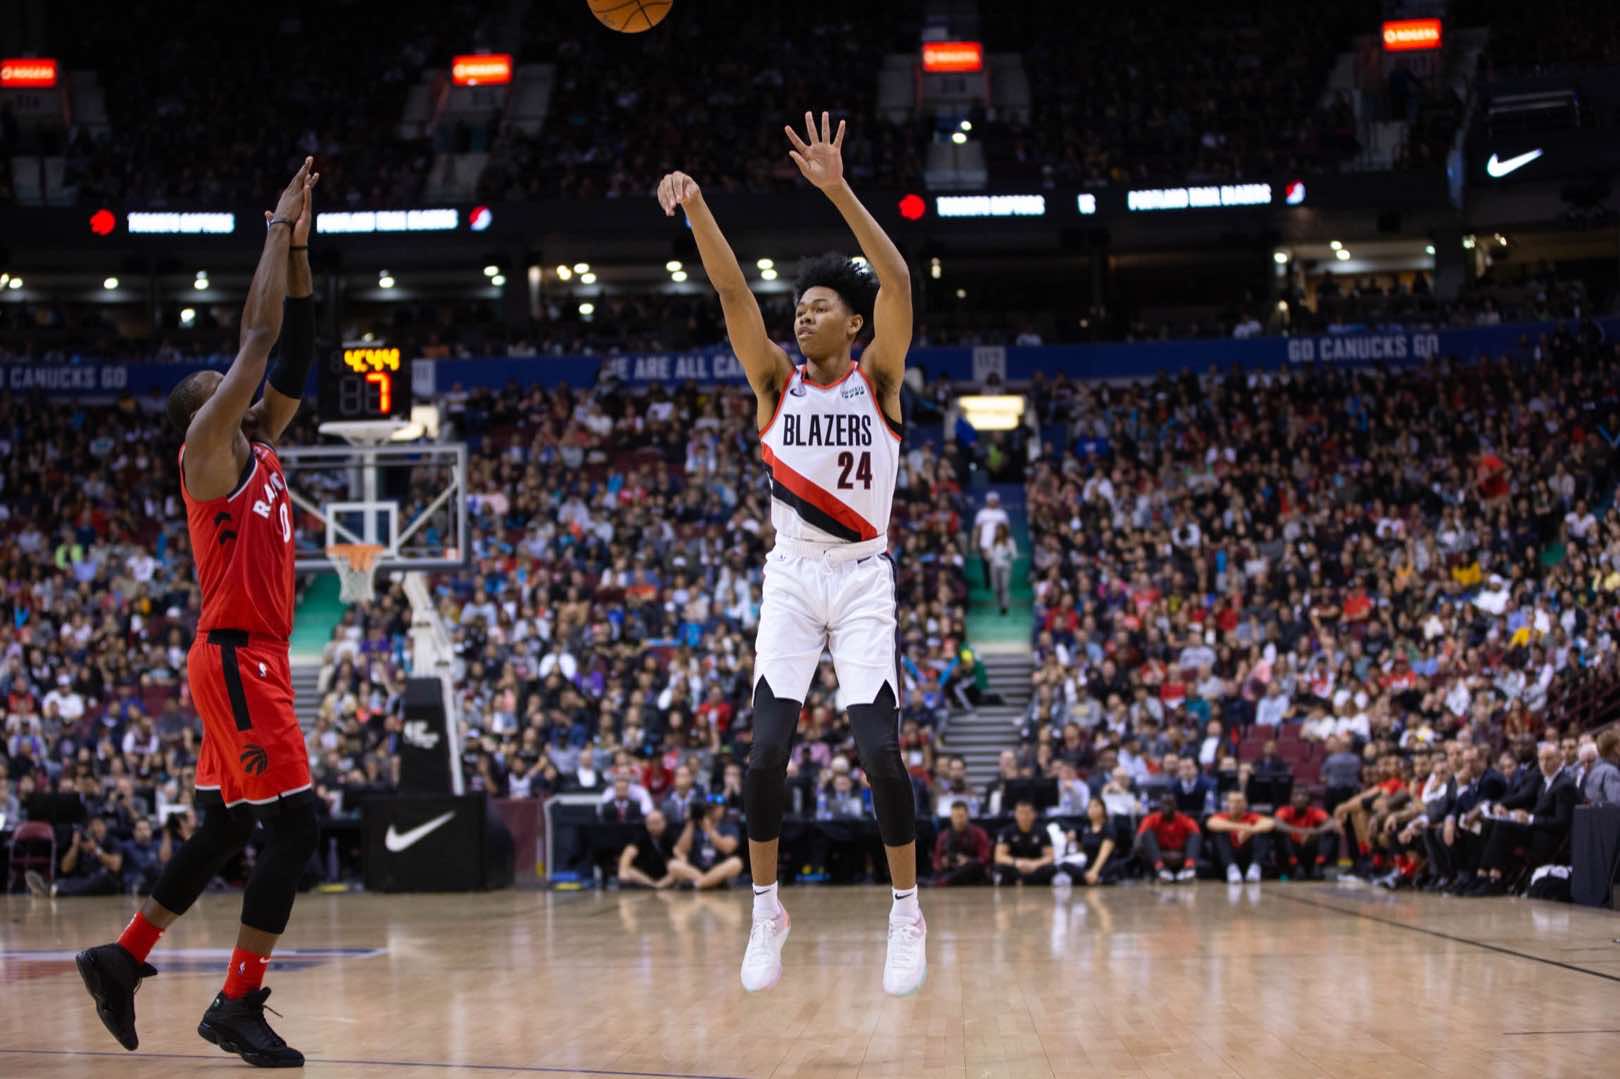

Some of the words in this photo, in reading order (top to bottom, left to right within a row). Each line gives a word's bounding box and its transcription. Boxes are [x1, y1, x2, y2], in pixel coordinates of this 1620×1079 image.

[1288, 338, 1315, 362] GO
[1319, 334, 1407, 361] CANUCKS
[10, 366, 97, 389] CANUCKS
[101, 366, 128, 389] GO
[633, 356, 670, 380] ARE
[674, 355, 707, 380] ALL
[365, 372, 391, 413] 7
[783, 413, 873, 447] BLAZERS
[837, 450, 873, 490] 24
